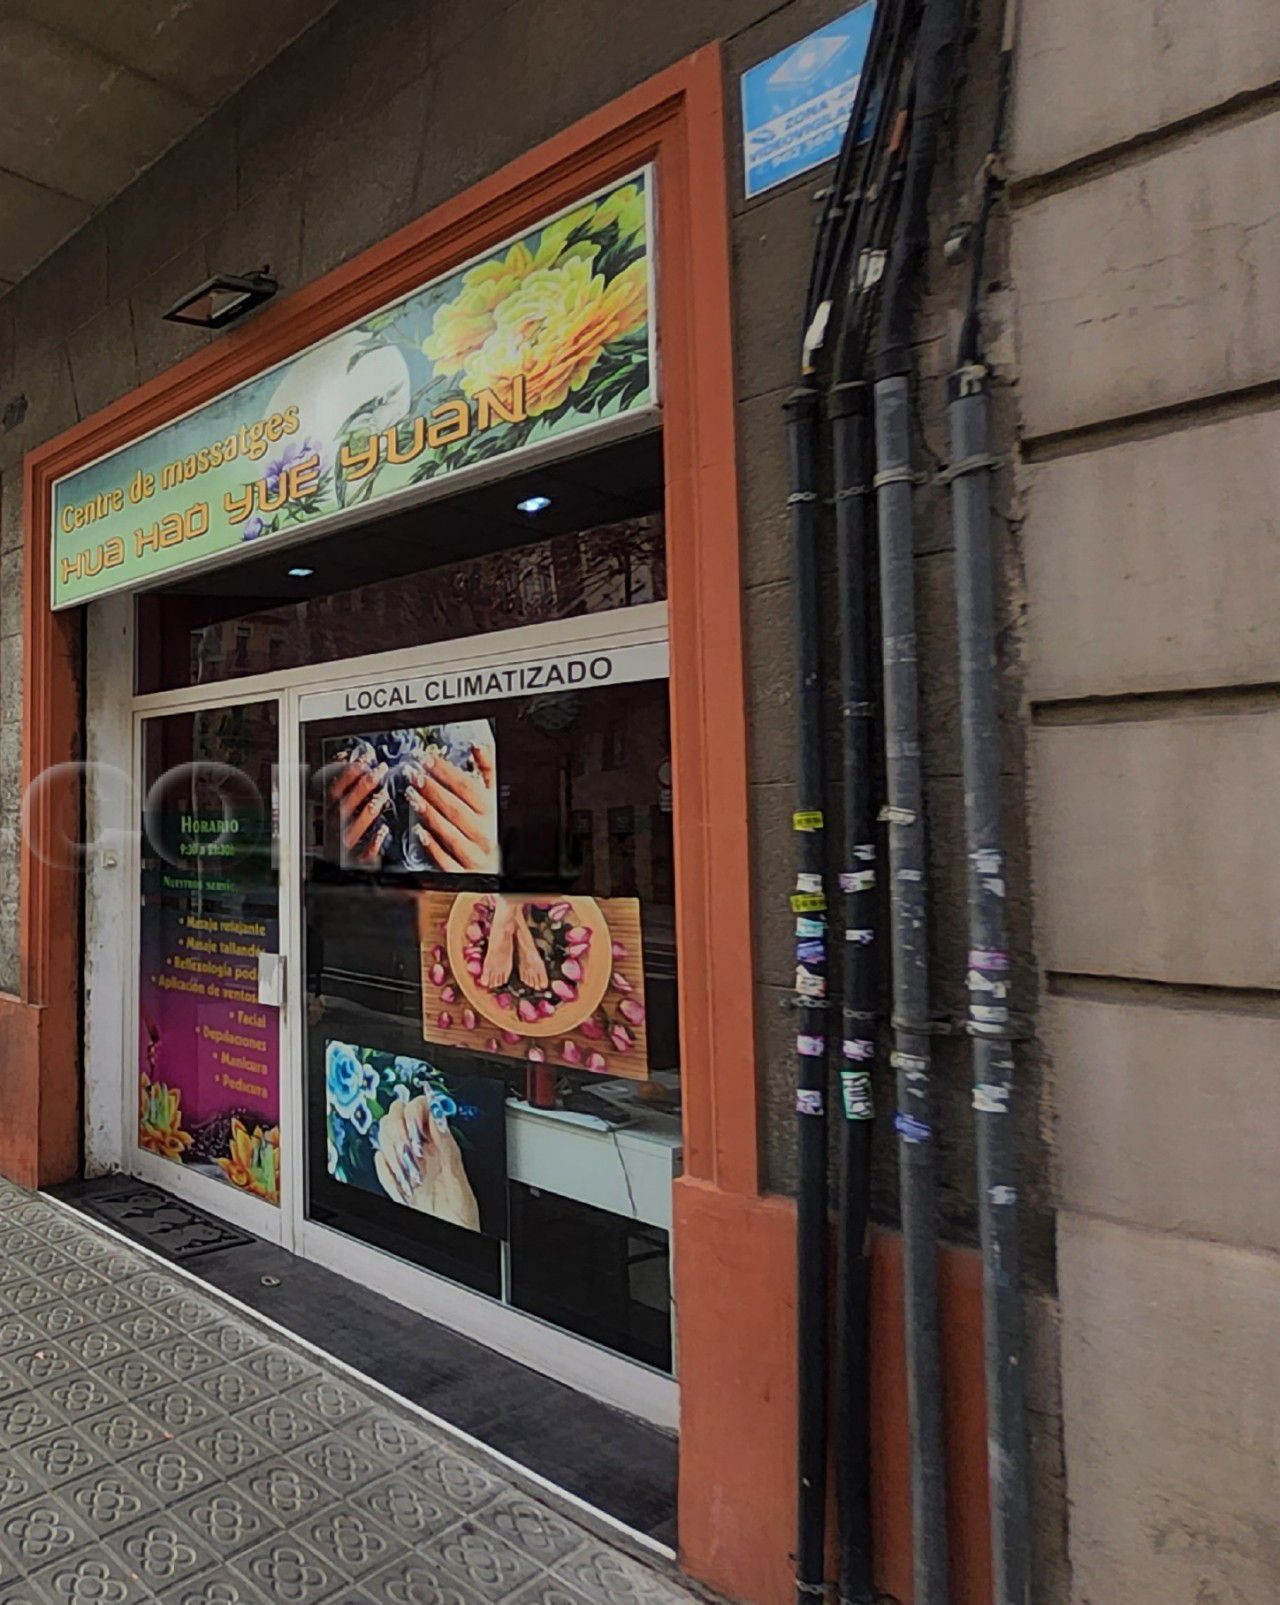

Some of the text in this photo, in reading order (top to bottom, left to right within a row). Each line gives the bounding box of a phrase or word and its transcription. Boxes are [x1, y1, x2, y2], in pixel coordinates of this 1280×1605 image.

[60, 405, 300, 534] Centre de massatges
[345, 656, 613, 712] LOCAL CLIMATIZADO
[235, 967, 257, 981] pod
[207, 983, 220, 997] de
[237, 1010, 267, 1028] Facial
[221, 1051, 268, 1076] Manicura
[222, 1073, 268, 1099] Pedicura
